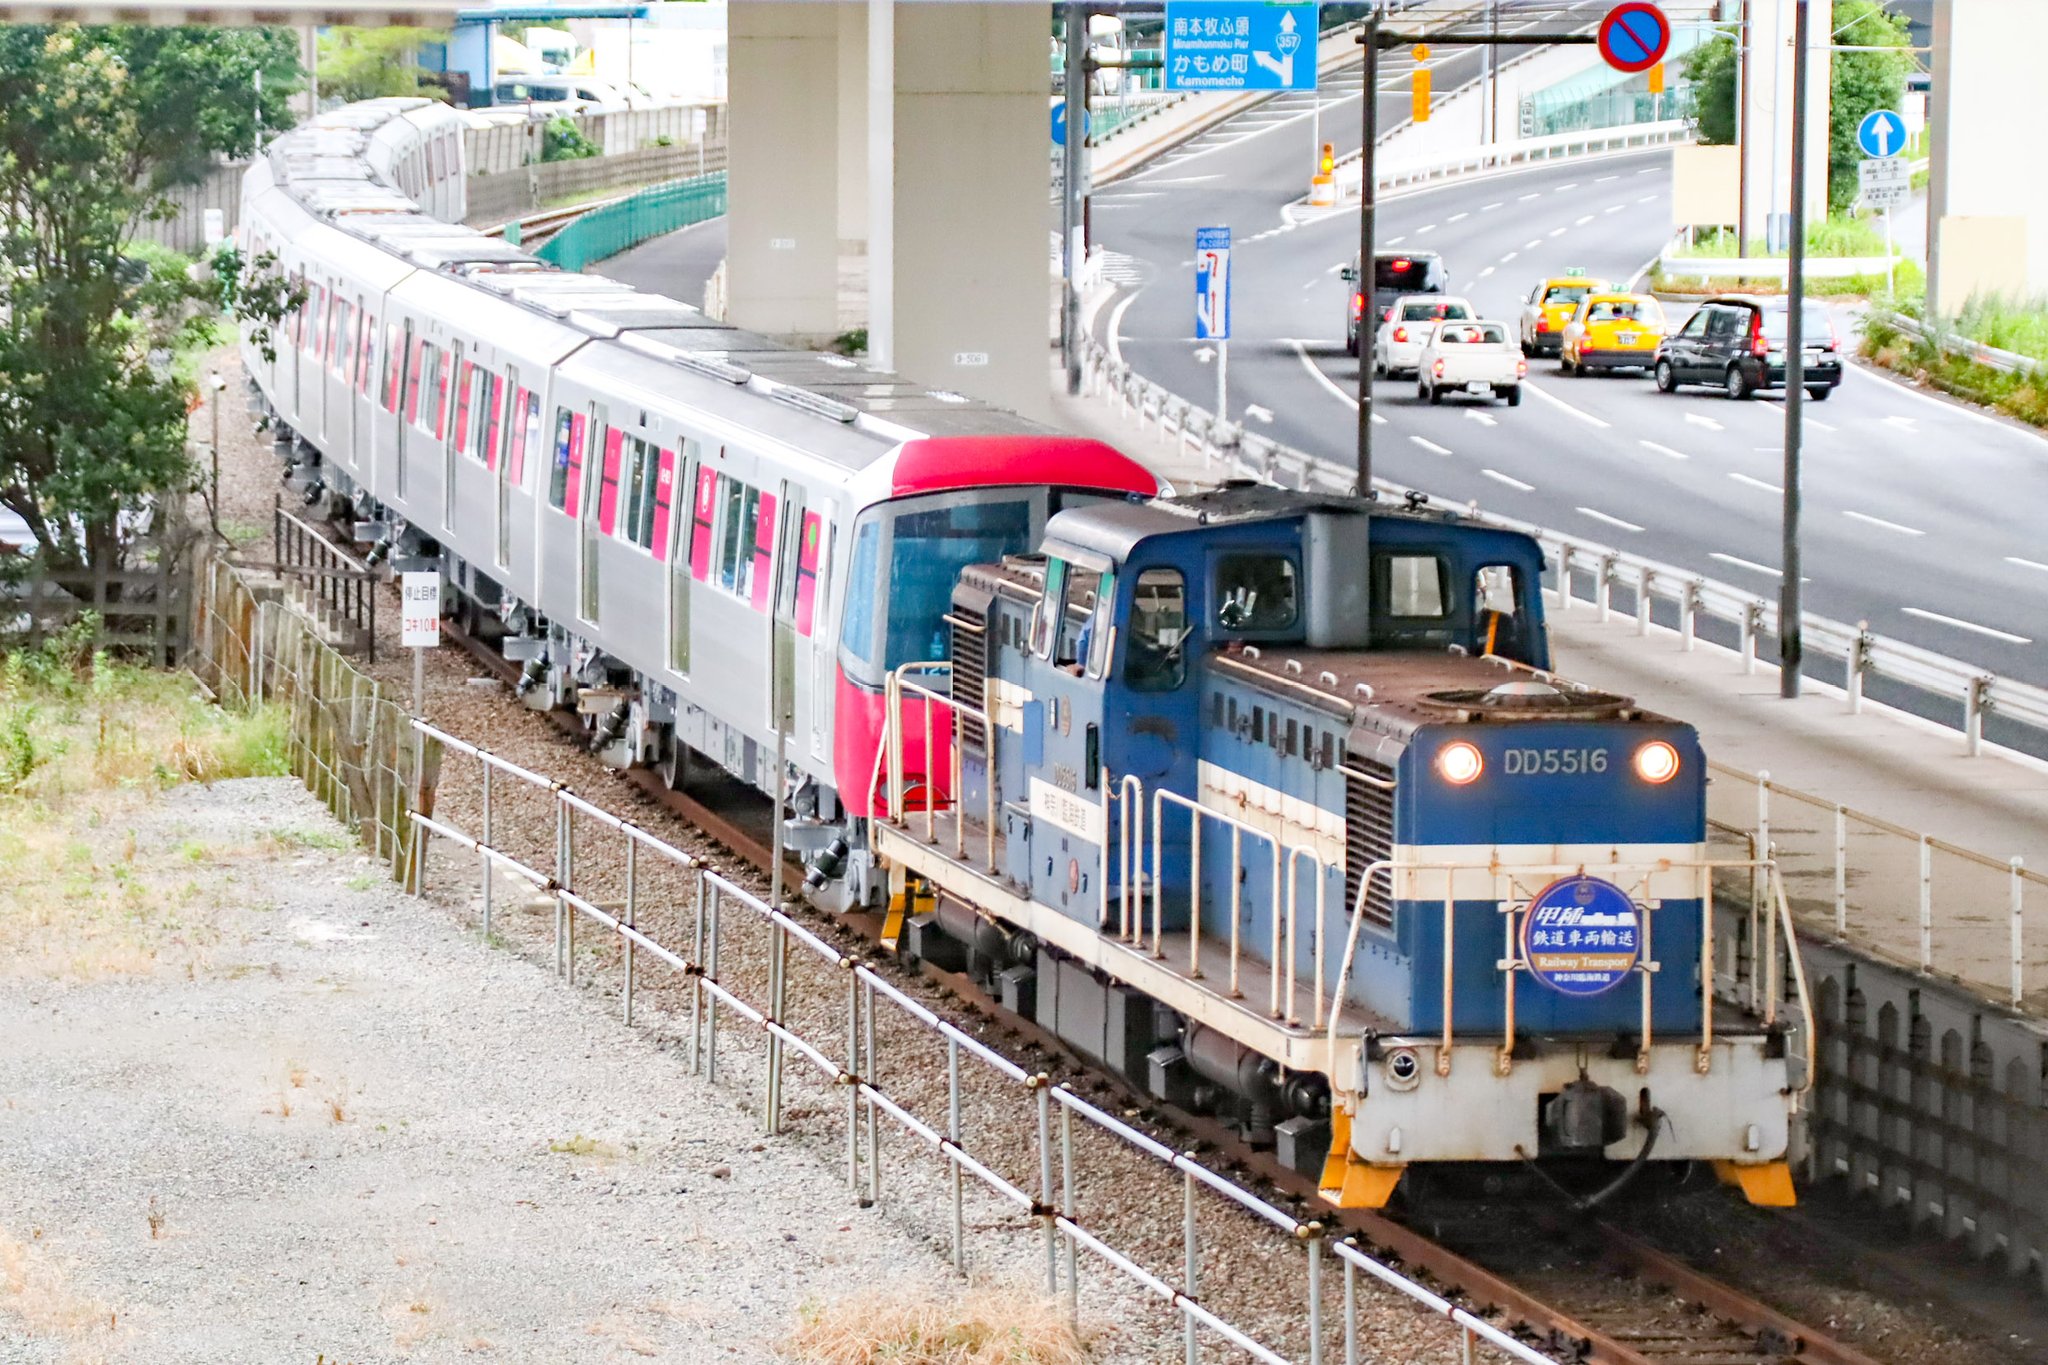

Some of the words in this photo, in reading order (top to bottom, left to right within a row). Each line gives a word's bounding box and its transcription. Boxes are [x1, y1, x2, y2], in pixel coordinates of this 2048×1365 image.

[1174, 17, 1249, 36] 南本牧ふ頭
[1173, 38, 1233, 49] Minamihonmoku
[1234, 38, 1249, 48] Pier
[1279, 36, 1297, 48] 357
[1174, 54, 1249, 74] かもめ町
[1177, 75, 1245, 86] Kamomecho
[405, 586, 437, 600] 停止目標
[1504, 748, 1608, 774] DD5516
[1536, 906, 1585, 927] 甲種
[1533, 929, 1635, 947] 鉄道車両輸送
[1539, 956, 1579, 969] Railway
[1581, 957, 1628, 970] Transport
